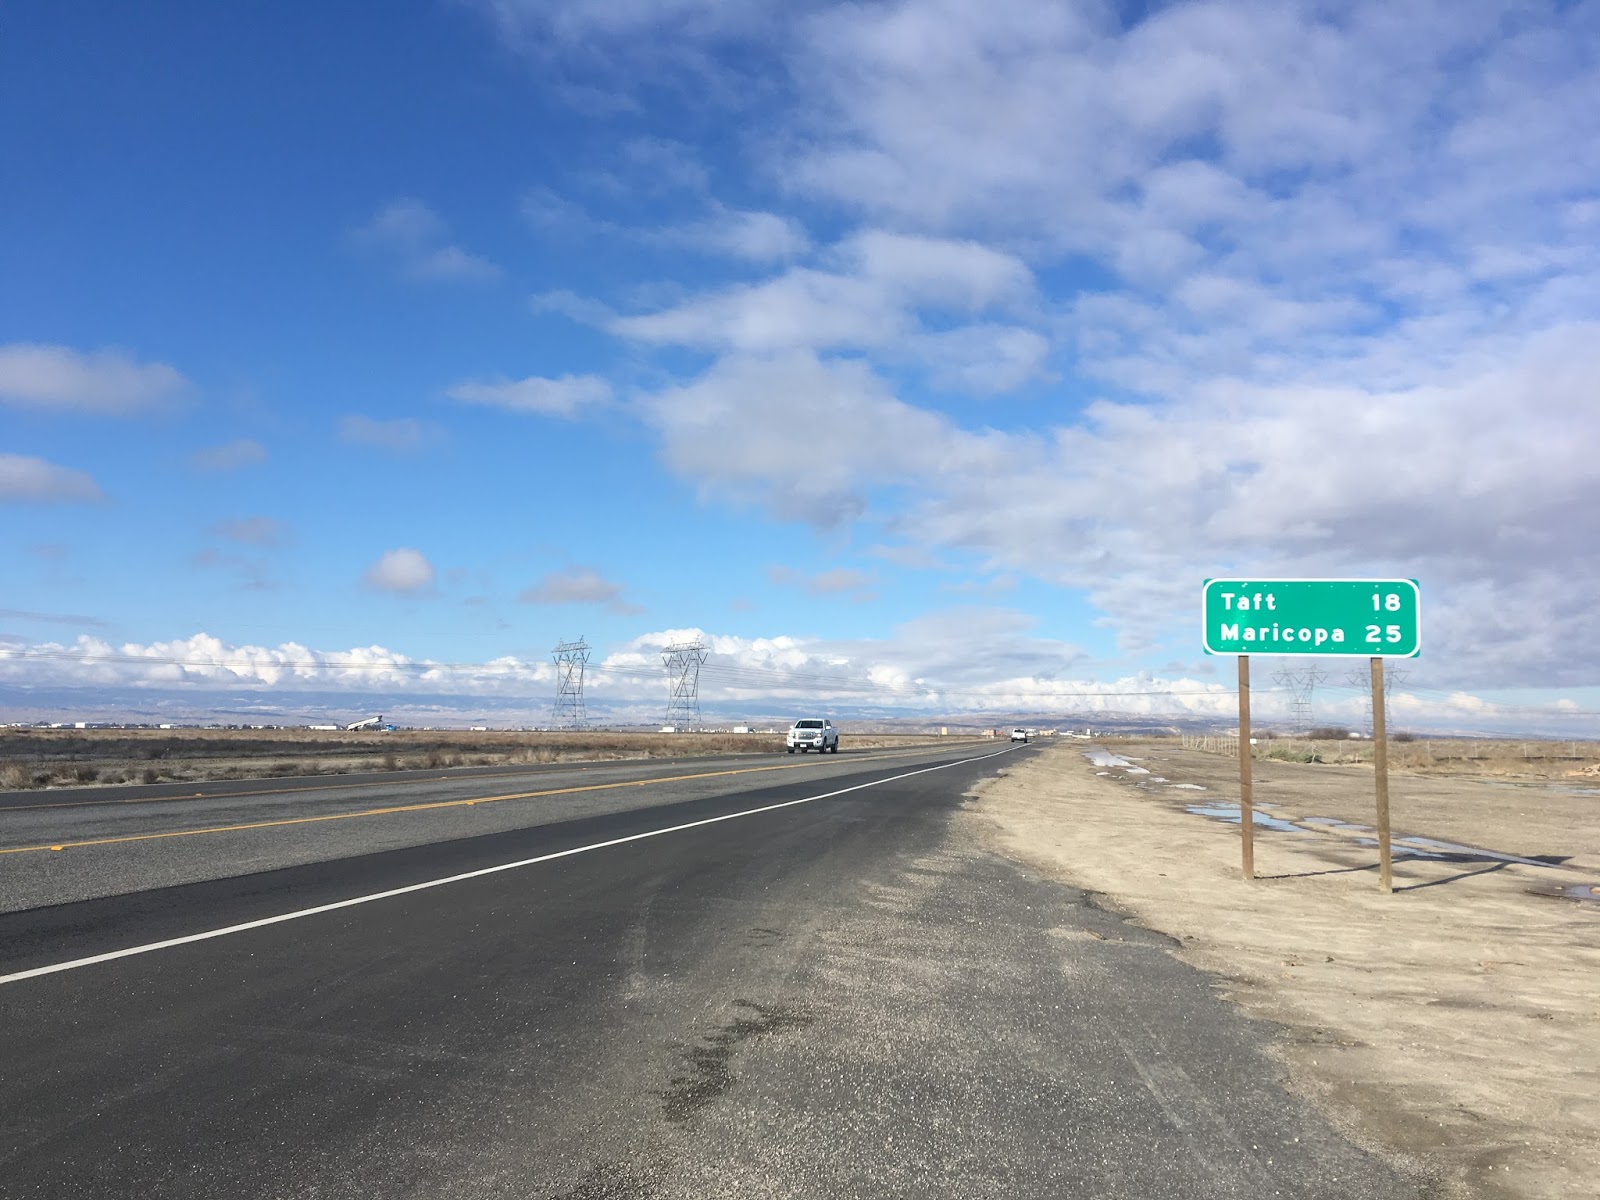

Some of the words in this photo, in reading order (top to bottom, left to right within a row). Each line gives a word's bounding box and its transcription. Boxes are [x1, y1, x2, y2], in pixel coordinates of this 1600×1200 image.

[1220, 593, 1276, 610] Taft
[1372, 594, 1401, 611] 18
[1221, 623, 1345, 646] Maricopa
[1365, 625, 1402, 643] 25
